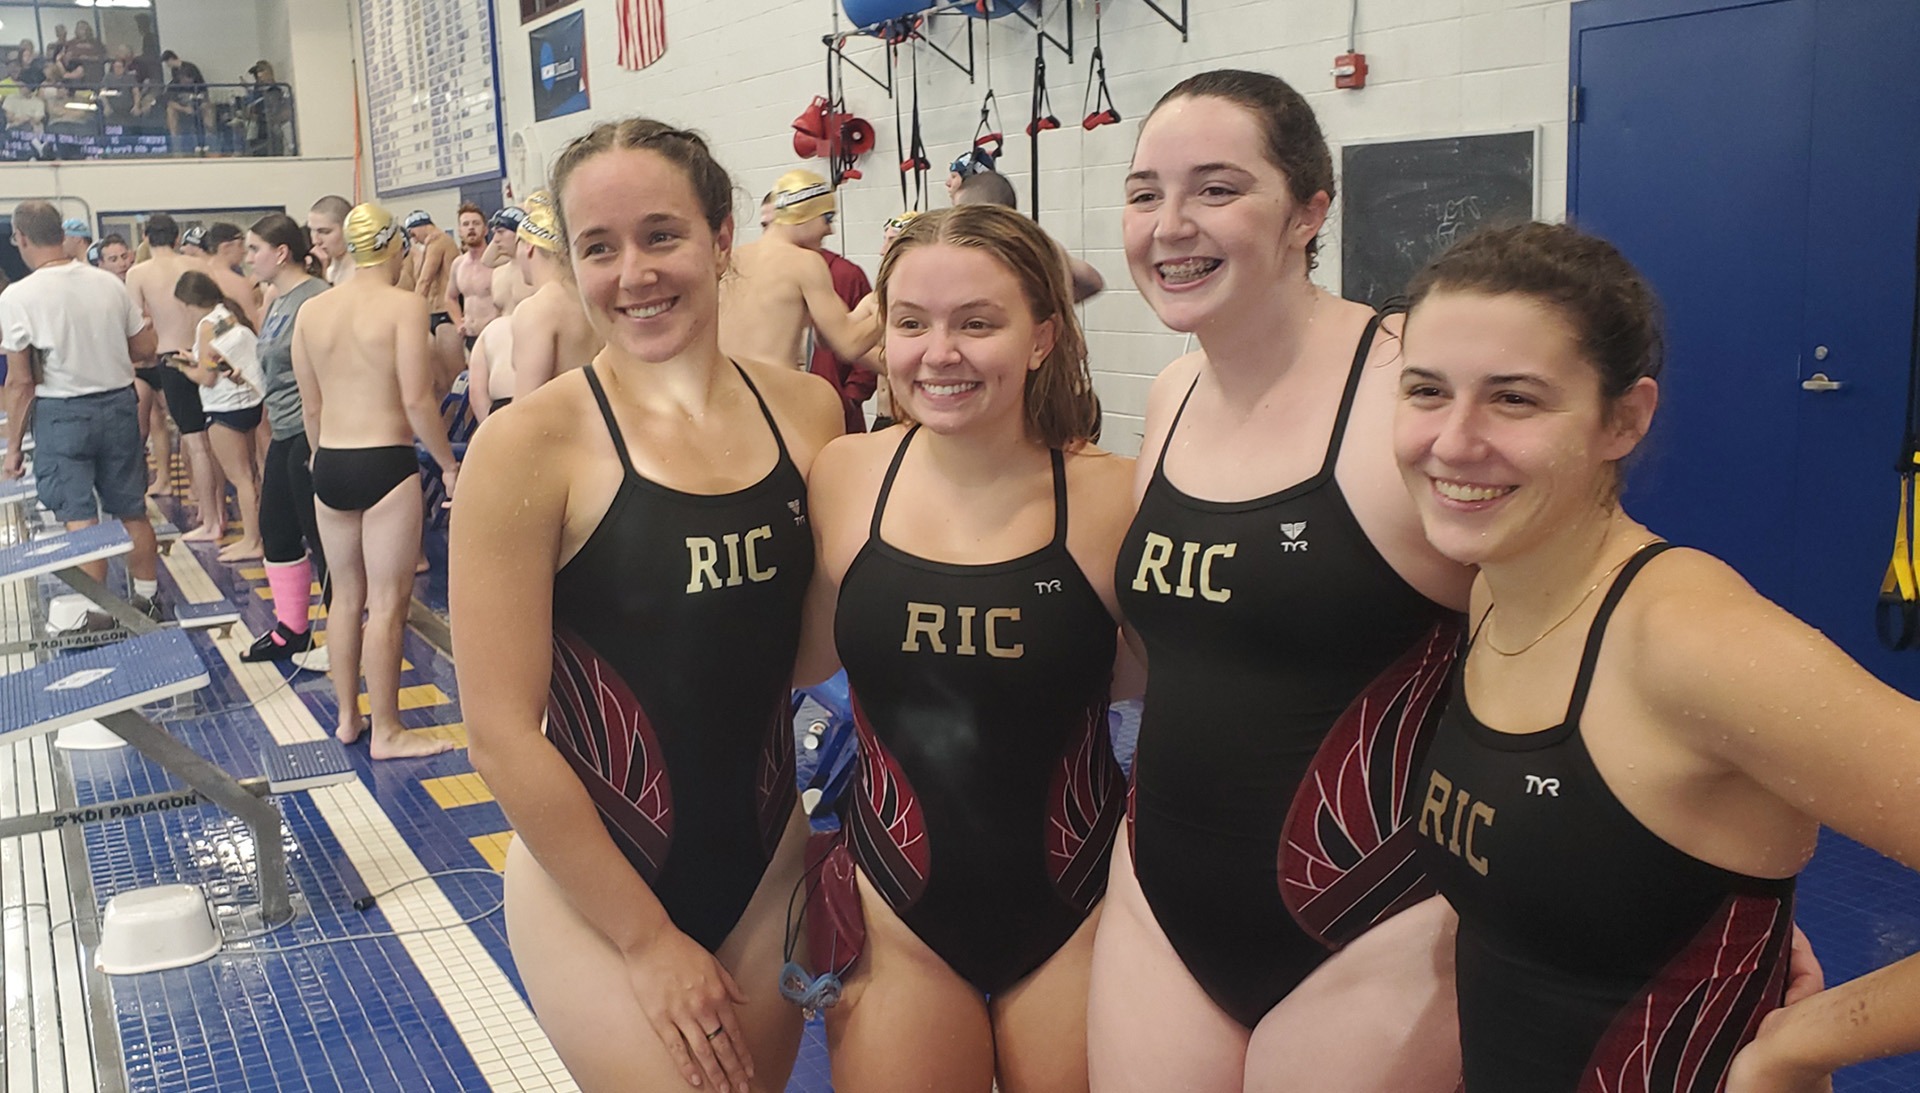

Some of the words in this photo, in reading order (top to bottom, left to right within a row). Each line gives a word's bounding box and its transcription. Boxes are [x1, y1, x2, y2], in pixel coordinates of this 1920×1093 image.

[685, 524, 777, 594] RIC
[1280, 540, 1309, 552] TYR
[1034, 579, 1063, 594] TYR
[1131, 531, 1238, 603] RIC
[901, 601, 1025, 659] RIC
[110, 794, 197, 818] PARAGON
[1524, 774, 1561, 797] TYR
[1418, 769, 1496, 877] RIC
